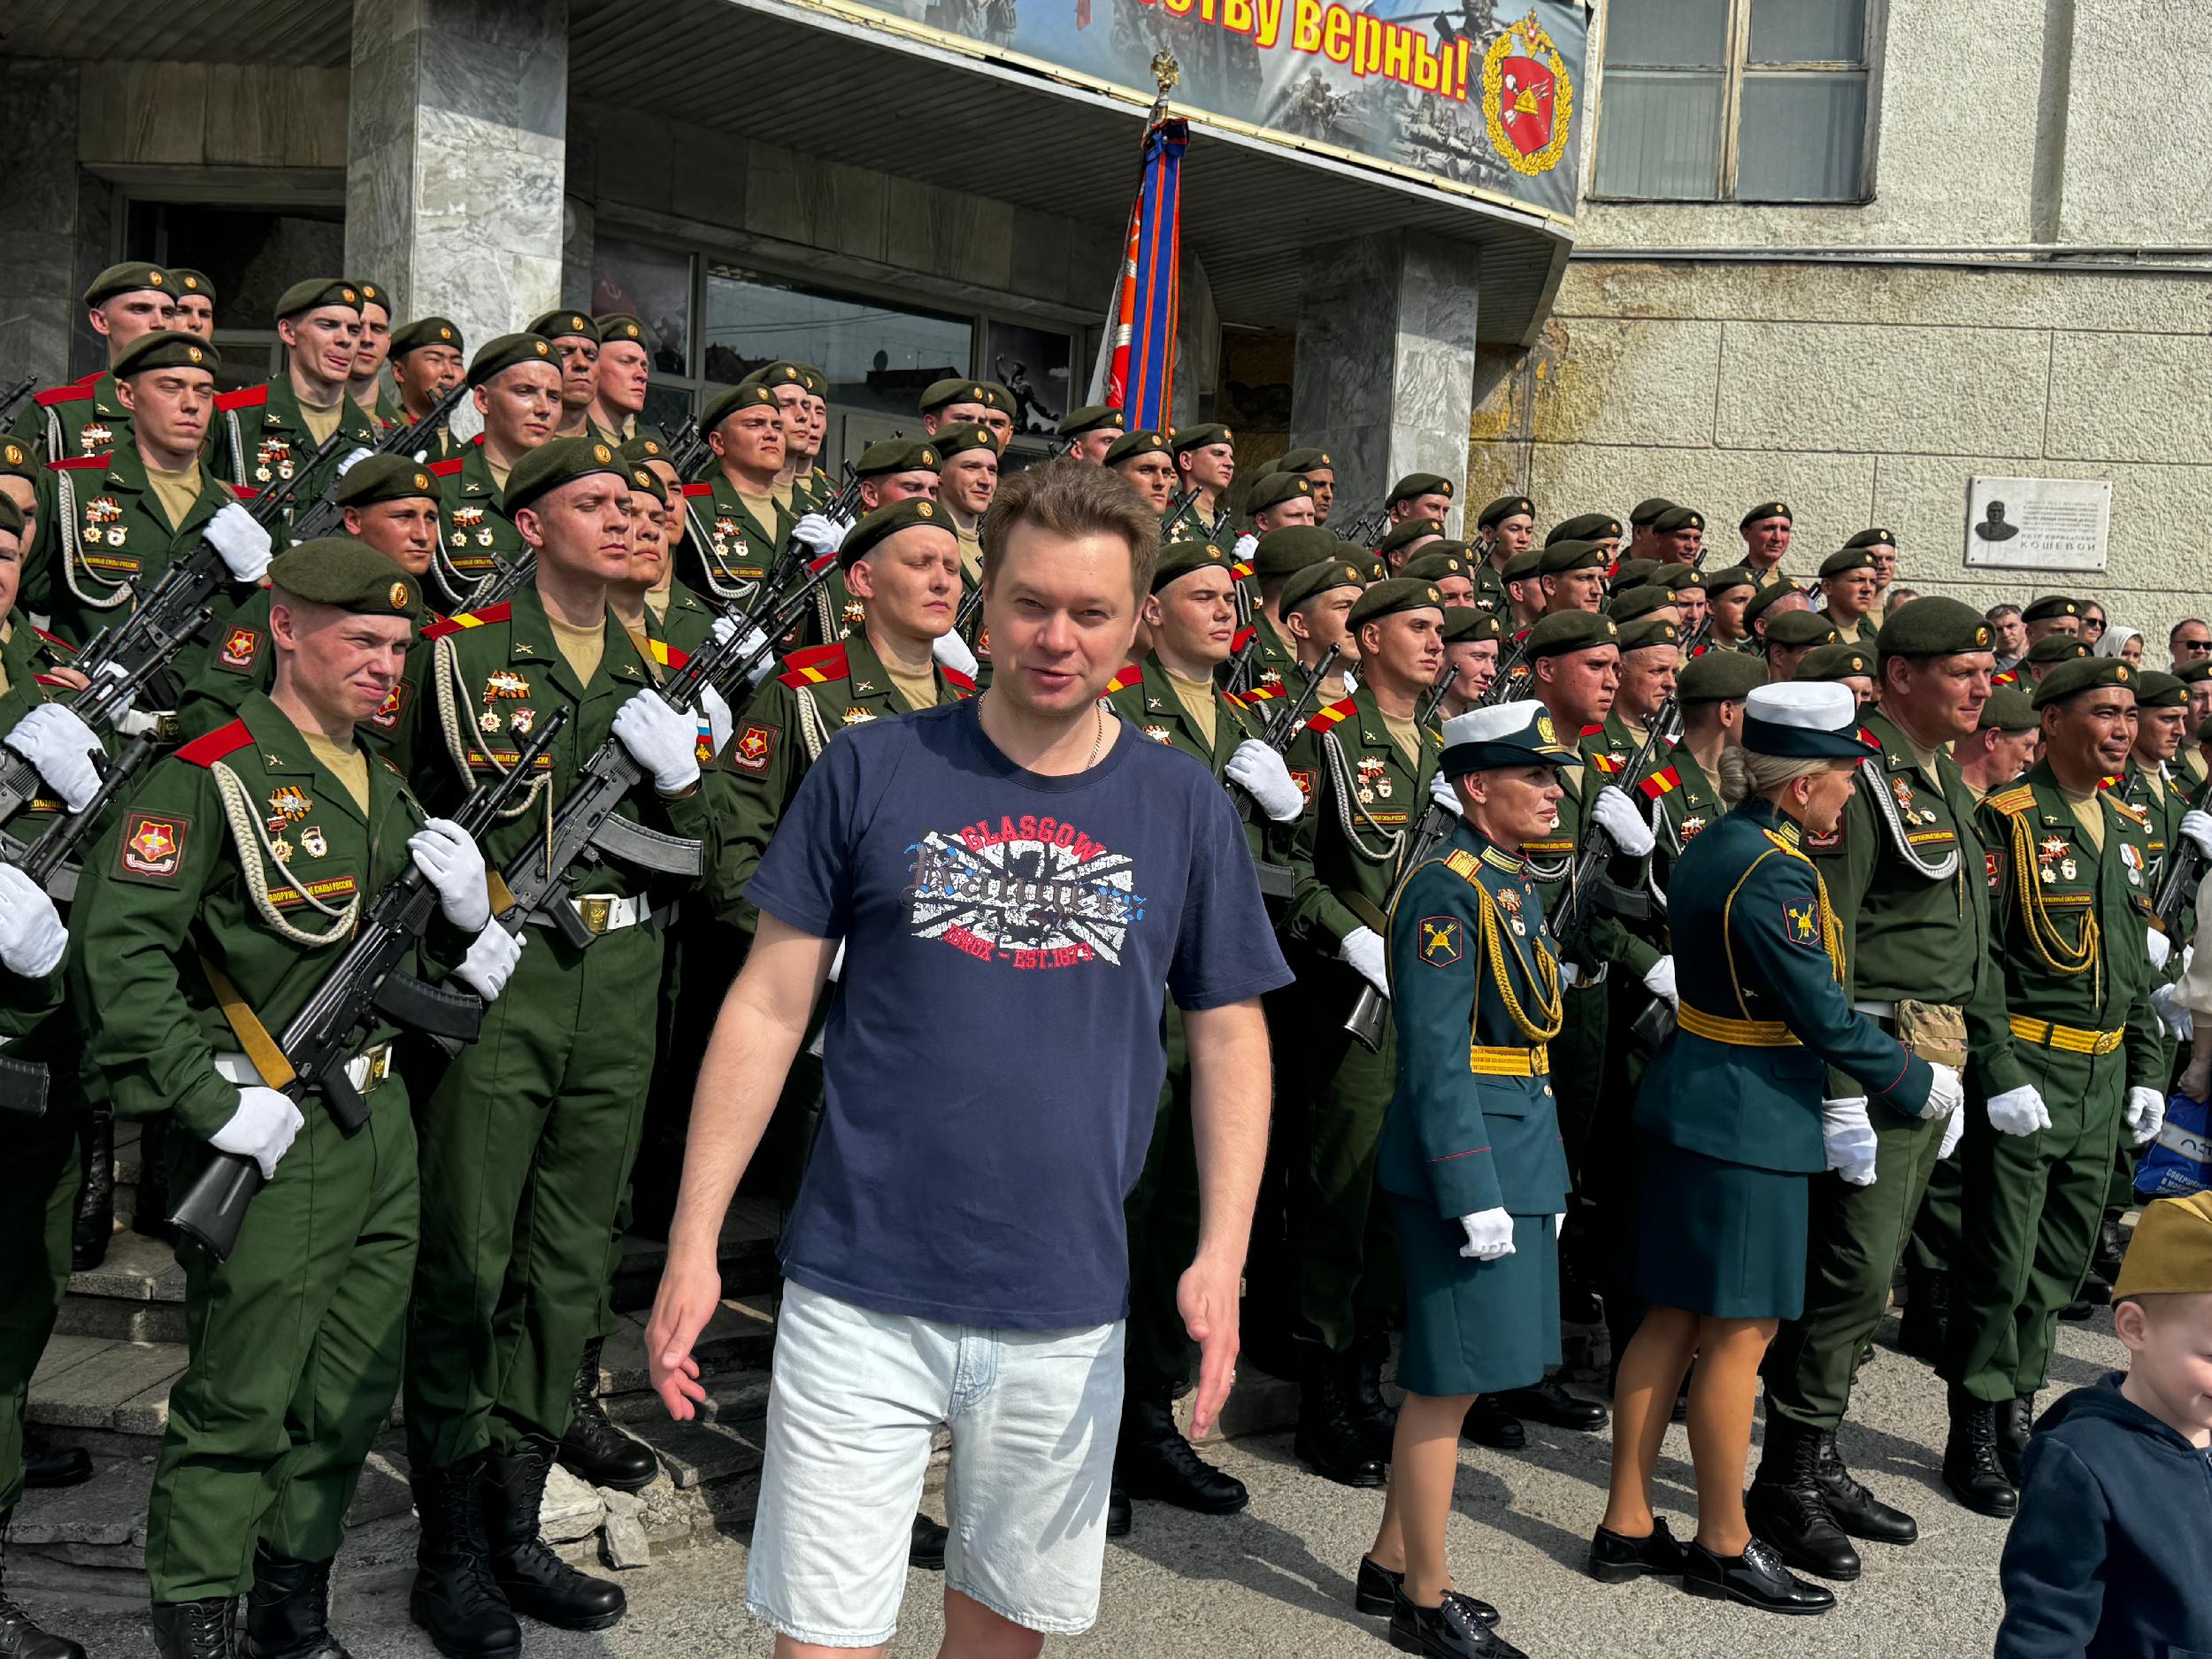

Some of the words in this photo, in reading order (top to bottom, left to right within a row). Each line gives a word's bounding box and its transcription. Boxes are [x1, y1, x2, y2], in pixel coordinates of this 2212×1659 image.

[1292, 0, 1471, 104] верны!
[959, 815, 1107, 863] GLASGOW
[314, 883, 332, 895] СИЛЫ
[332, 879, 353, 891] РОССИИ
[941, 923, 997, 963] IBROX
